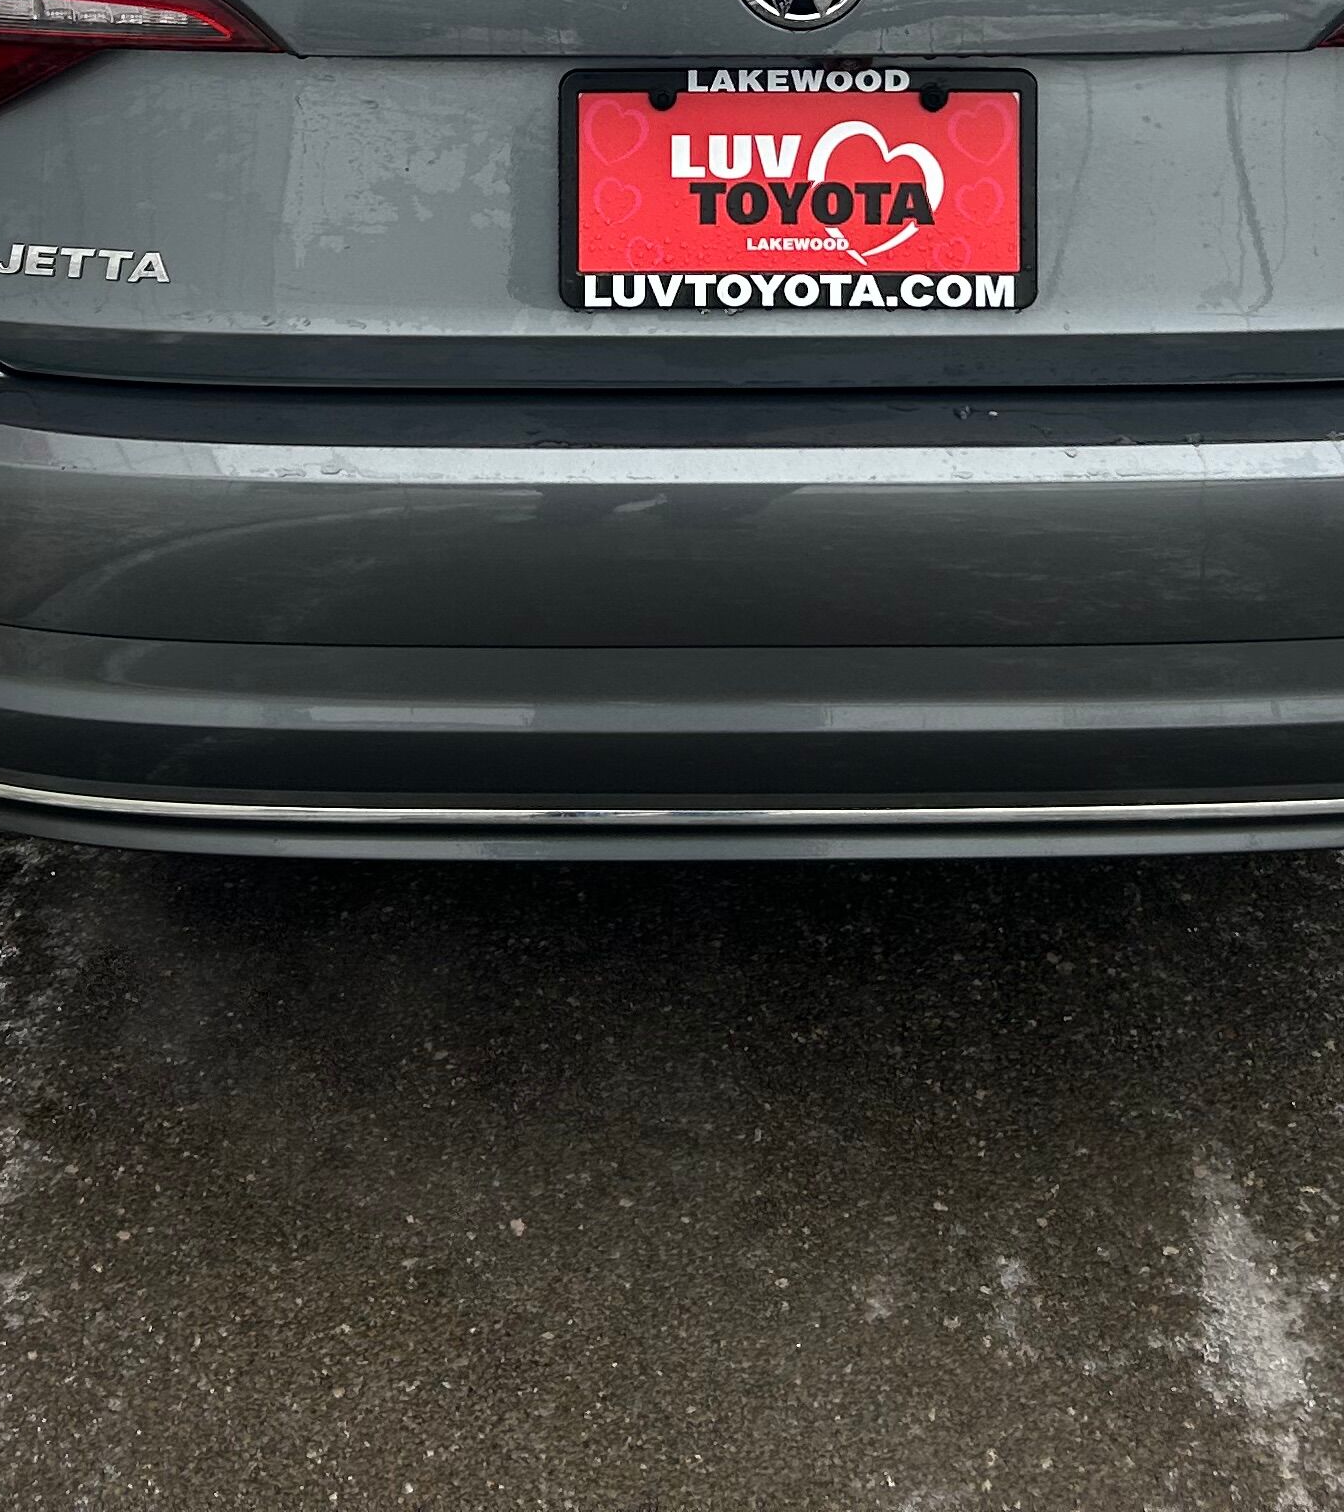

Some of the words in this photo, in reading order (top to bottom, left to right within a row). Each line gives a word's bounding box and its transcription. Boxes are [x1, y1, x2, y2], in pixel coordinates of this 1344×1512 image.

[687, 69, 911, 93] LAKEWOOD
[670, 134, 803, 179] LUV
[689, 181, 936, 226] TOYOTA
[746, 236, 850, 252] LAKEWOOD
[583, 274, 1016, 308] LUVTOYOTA.COM
